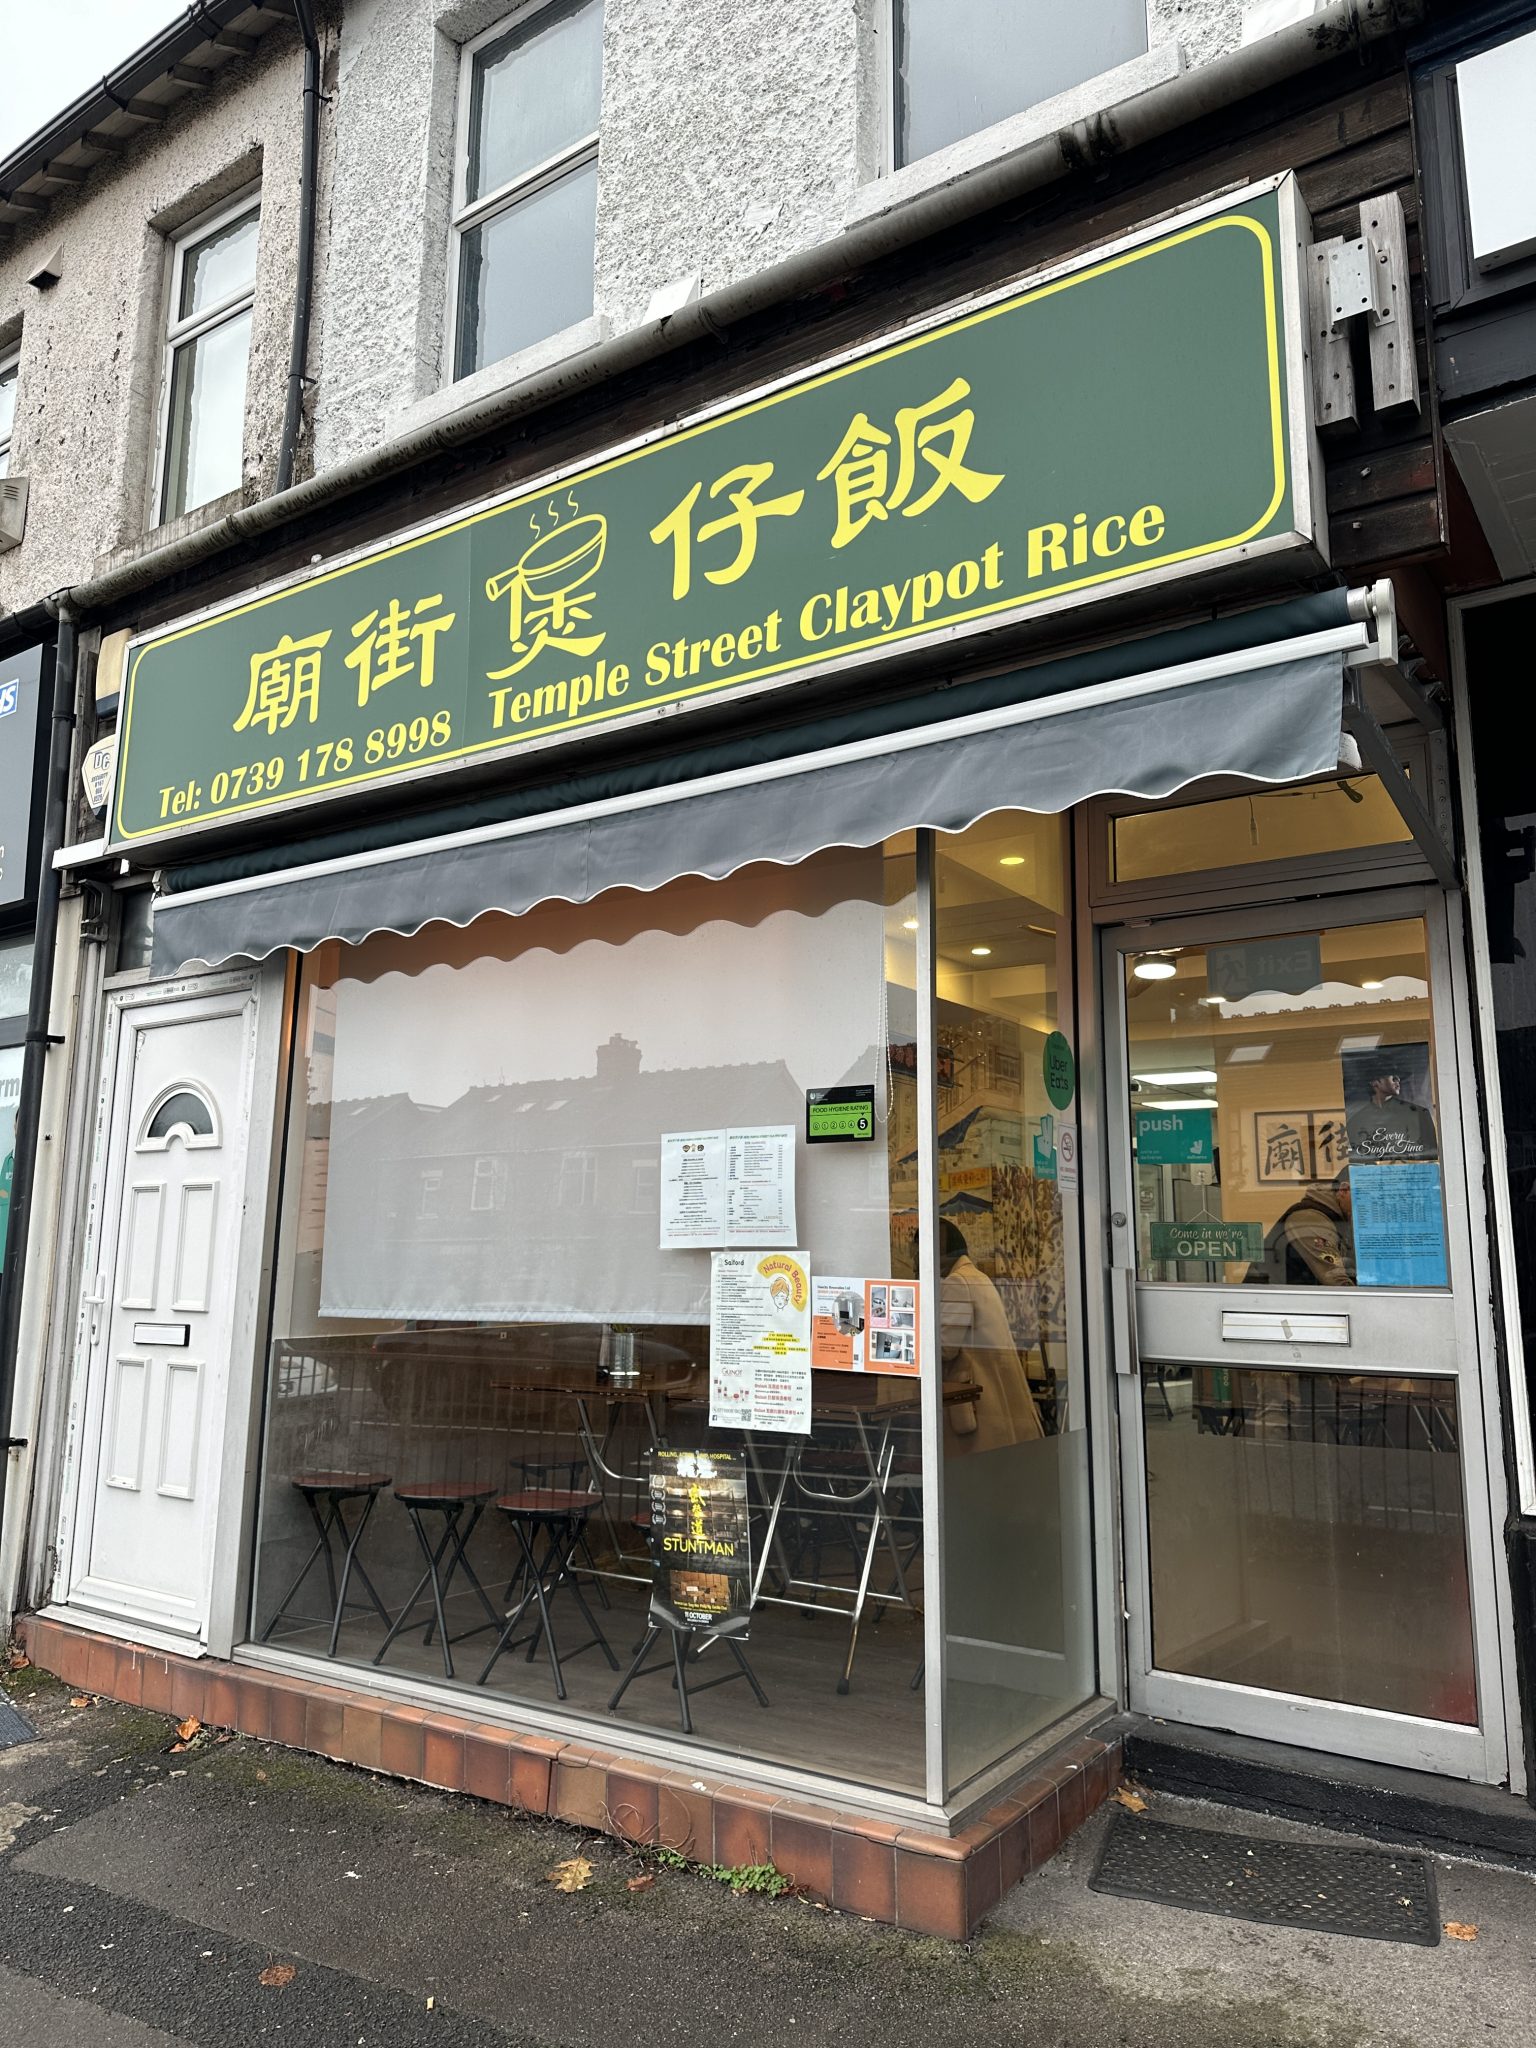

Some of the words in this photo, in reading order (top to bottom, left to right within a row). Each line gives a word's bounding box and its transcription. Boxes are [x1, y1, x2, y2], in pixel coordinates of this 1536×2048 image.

[488, 660, 630, 729] Temple
[645, 611, 781, 686] Street
[800, 542, 1004, 641] Claypot
[1027, 504, 1166, 579] Rice
[158, 785, 203, 818] Tel:
[210, 757, 286, 804] 0739
[299, 737, 354, 783] 178
[366, 710, 452, 761] 8998
[1050, 1055, 1068, 1072] Uber
[1050, 1074, 1069, 1090] Eats
[1139, 1114, 1183, 1137] push
[1372, 1127, 1406, 1143] Every
[1356, 1140, 1394, 1158] Single
[1393, 1139, 1424, 1154] Time
[1170, 1227, 1199, 1239] Come
[1201, 1228, 1212, 1239] in
[1215, 1228, 1244, 1240] we're
[1177, 1240, 1237, 1257] OPEN
[763, 1261, 793, 1274] Natural
[791, 1270, 803, 1305] Beauty
[663, 1537, 734, 1556] STUNTMAN
[690, 1612, 713, 1621] OCTOBER
